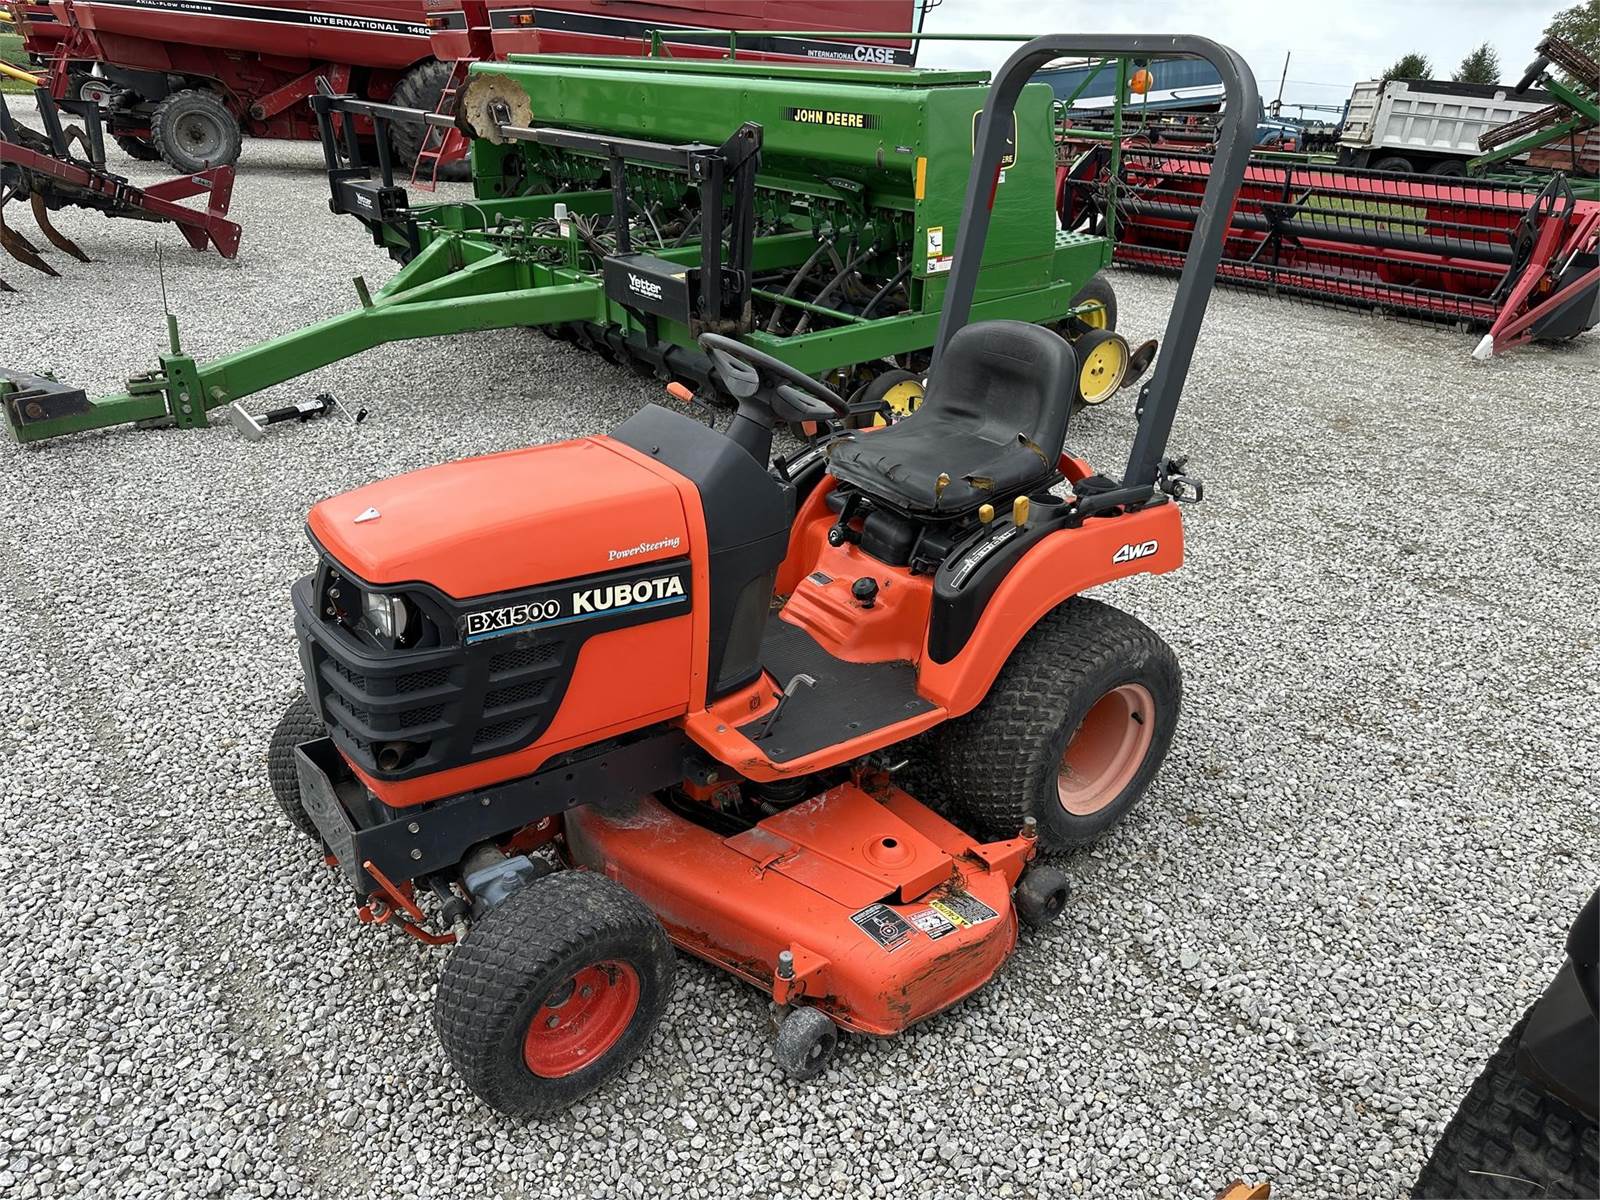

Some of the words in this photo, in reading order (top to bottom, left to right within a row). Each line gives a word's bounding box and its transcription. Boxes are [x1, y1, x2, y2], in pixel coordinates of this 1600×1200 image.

[309, 16, 399, 32] INTERNATIONAL
[407, 26, 431, 34] 1460
[807, 50, 854, 60] INTERNATIONAL
[854, 46, 895, 64] CASE
[794, 108, 823, 124] JOHN
[826, 111, 864, 128] DEERE
[628, 272, 661, 293] Yetter
[608, 536, 680, 561] PowerSteering
[1112, 540, 1158, 565] 4WD
[467, 600, 560, 635] BX1500
[572, 576, 684, 615] KUBOTA
